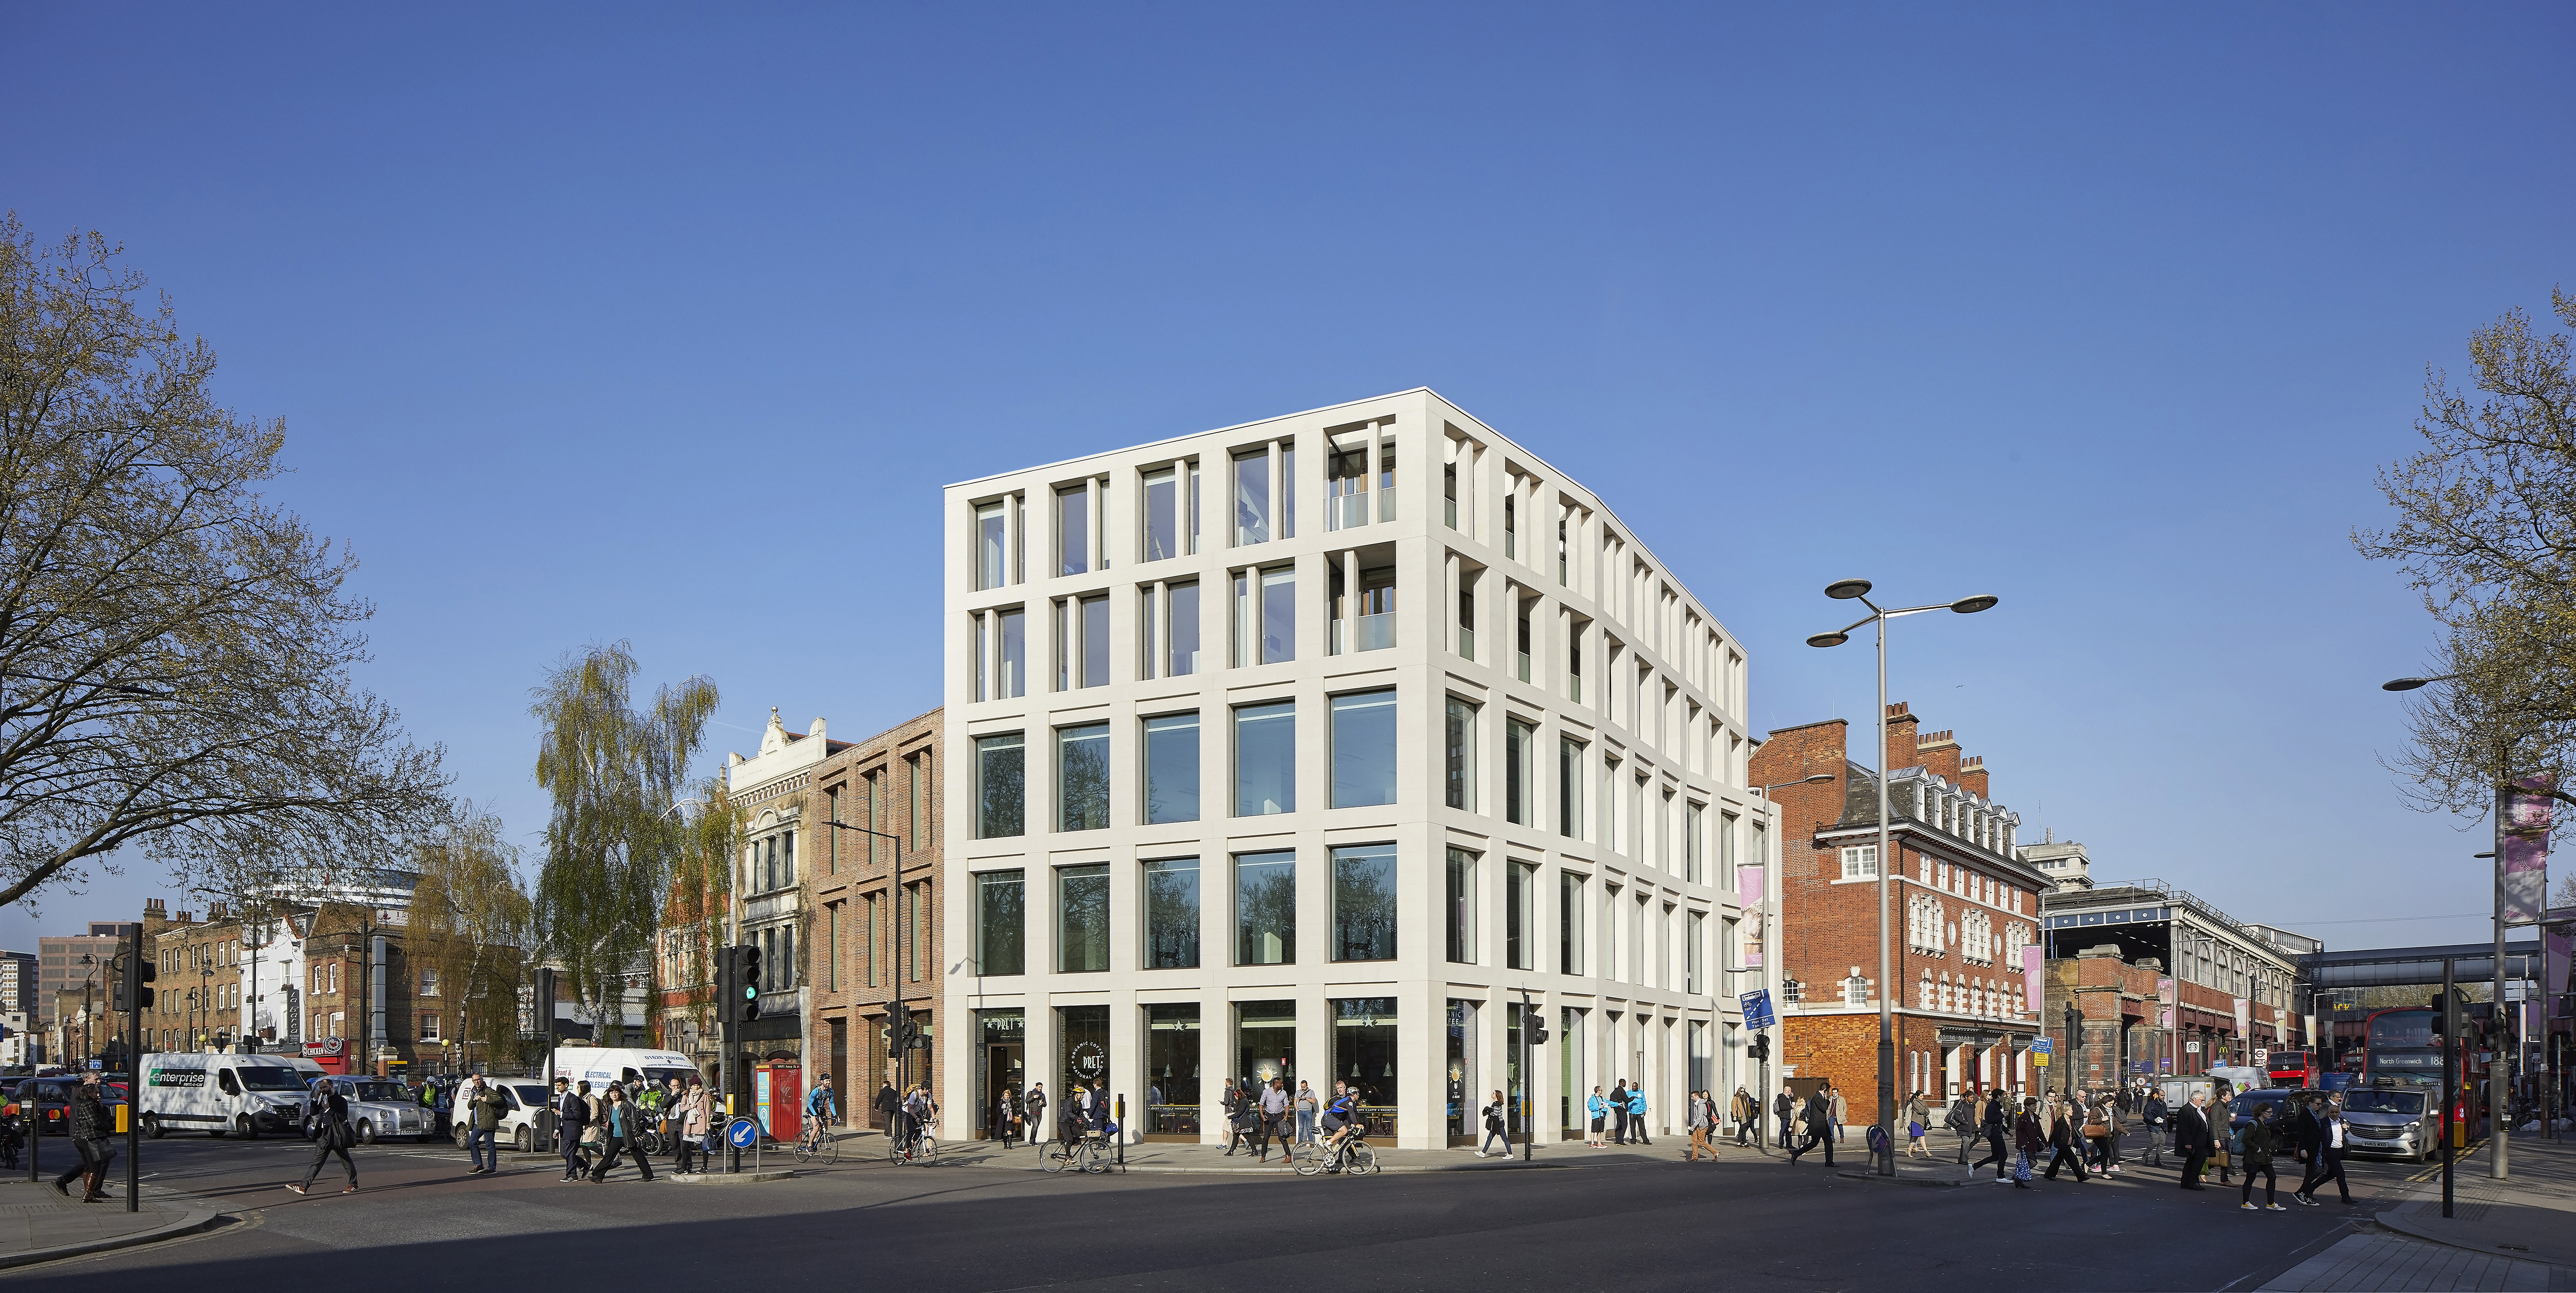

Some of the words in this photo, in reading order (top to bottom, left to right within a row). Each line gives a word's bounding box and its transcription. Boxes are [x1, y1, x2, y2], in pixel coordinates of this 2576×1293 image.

[290, 992, 298, 1003] La
[289, 1006, 299, 1034] Barca
[997, 1018, 1014, 1030] PRET
[1072, 1042, 1088, 1059] ORGANIC
[1090, 1042, 1104, 1058] COFFEE
[1083, 1056, 1100, 1069] PRET
[2431, 1056, 2444, 1065] 188
[150, 1072, 205, 1084] enterprise
[1073, 1066, 1092, 1079] NATURAL
[1093, 1065, 1103, 1077] FOOD
